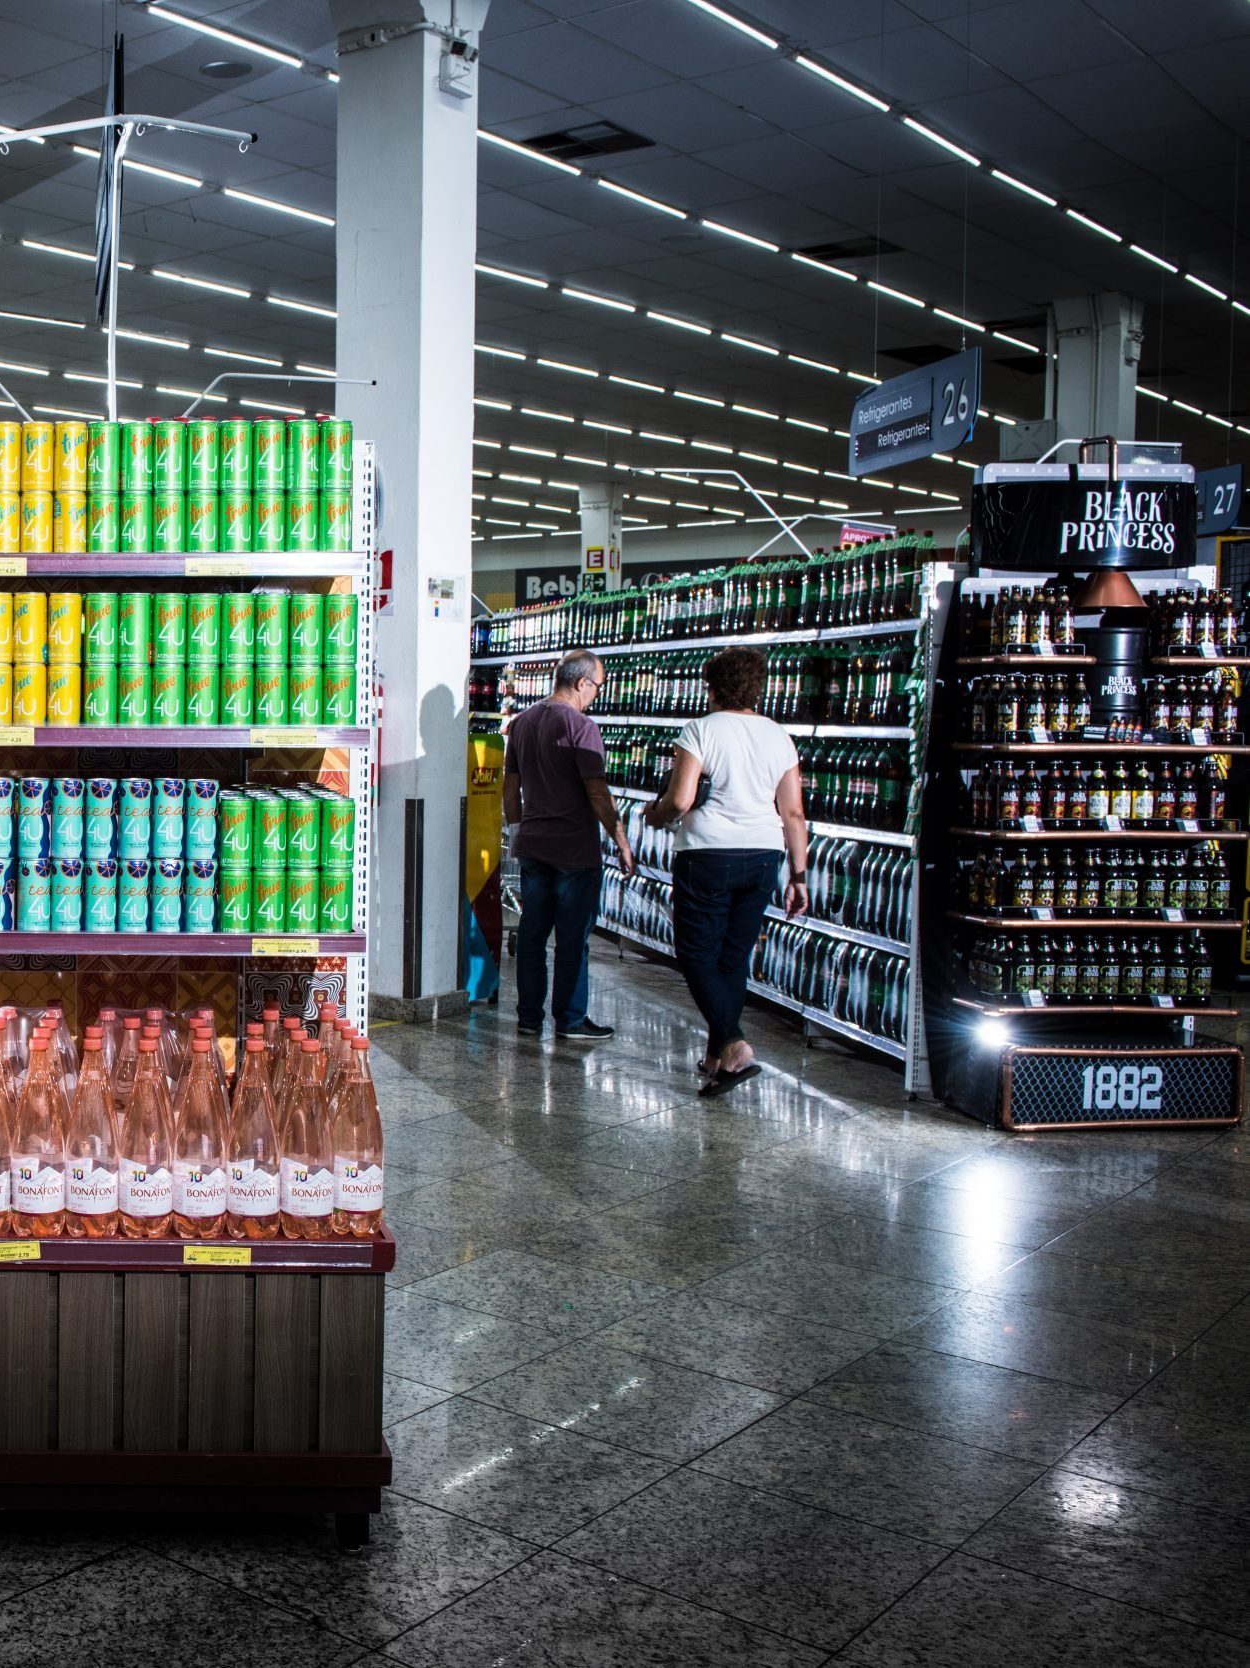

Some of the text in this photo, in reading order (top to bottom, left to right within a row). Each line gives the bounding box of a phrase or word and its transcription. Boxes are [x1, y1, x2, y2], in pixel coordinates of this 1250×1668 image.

[858, 379, 968, 427] Refrigerantes 26
[25, 432, 48, 454] true
[191, 431, 214, 454] true
[257, 431, 281, 454] true
[878, 421, 927, 448] Refrigerantes
[1085, 491, 1165, 522] BLACK
[1214, 483, 1236, 515] 27
[90, 501, 114, 524] true
[154, 501, 178, 524] true
[190, 501, 213, 524] true
[289, 501, 314, 524] true
[1060, 521, 1176, 554] PRINCESS
[589, 551, 602, 567] E
[88, 604, 111, 628] true
[158, 604, 182, 628] true
[190, 604, 214, 628] true
[291, 604, 316, 628] true
[120, 675, 144, 699] true
[224, 675, 248, 699] true
[257, 675, 280, 699] true
[290, 675, 315, 699] true
[1101, 685, 1137, 696] PRINCESS
[1108, 675, 1133, 686] BLACK
[58, 803, 83, 817] tea
[125, 803, 150, 817] tea
[190, 804, 217, 816] tea
[222, 810, 247, 832] true
[290, 810, 314, 832] true
[121, 883, 149, 896] tea
[155, 883, 182, 896] tea
[223, 880, 247, 902] true
[256, 880, 282, 902] true
[1082, 1065, 1163, 1110] 1882
[20, 1167, 32, 1180] 10
[72, 1167, 84, 1180] 10
[132, 1169, 146, 1182] 10
[189, 1169, 203, 1182] 10
[232, 1167, 243, 1180] 10
[294, 1169, 308, 1182] 10
[344, 1167, 359, 1178] 10
[18, 1184, 63, 1197] BONAFONT
[70, 1185, 116, 1197] BONAFONT
[230, 1185, 275, 1198] BONAFONT
